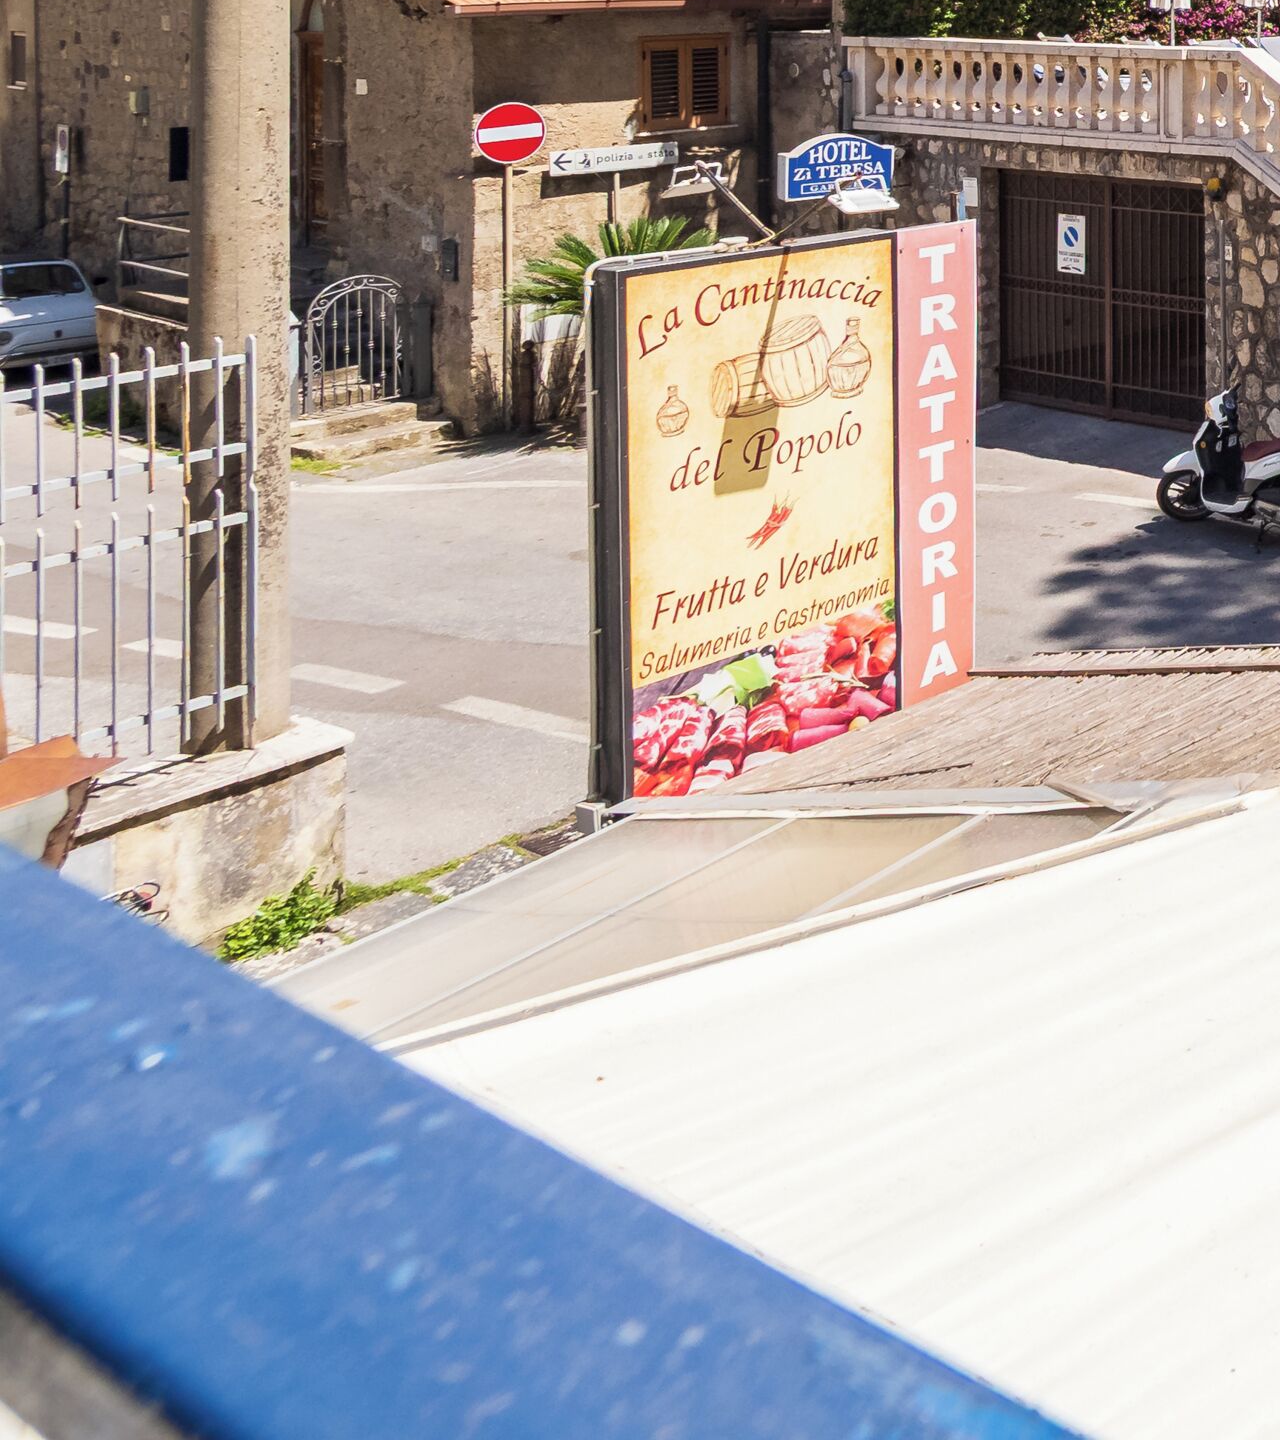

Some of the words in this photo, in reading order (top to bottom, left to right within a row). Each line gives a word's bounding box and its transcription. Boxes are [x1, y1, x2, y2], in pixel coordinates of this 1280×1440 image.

[596, 152, 634, 164] polizia
[647, 149, 675, 158] stato
[808, 140, 872, 164] HOTEL
[815, 160, 885, 178] TERESA
[639, 304, 684, 360] La
[694, 270, 883, 327] Cantinaccia
[669, 438, 733, 492] del
[743, 410, 862, 474] Popolo
[917, 242, 959, 689] TRATTORIA
[651, 576, 746, 630] Frutta
[754, 572, 769, 597] e
[779, 536, 879, 589] Verdura
[639, 625, 752, 680] Salumeria
[757, 620, 769, 640] e
[773, 576, 891, 634] Gastronomia
